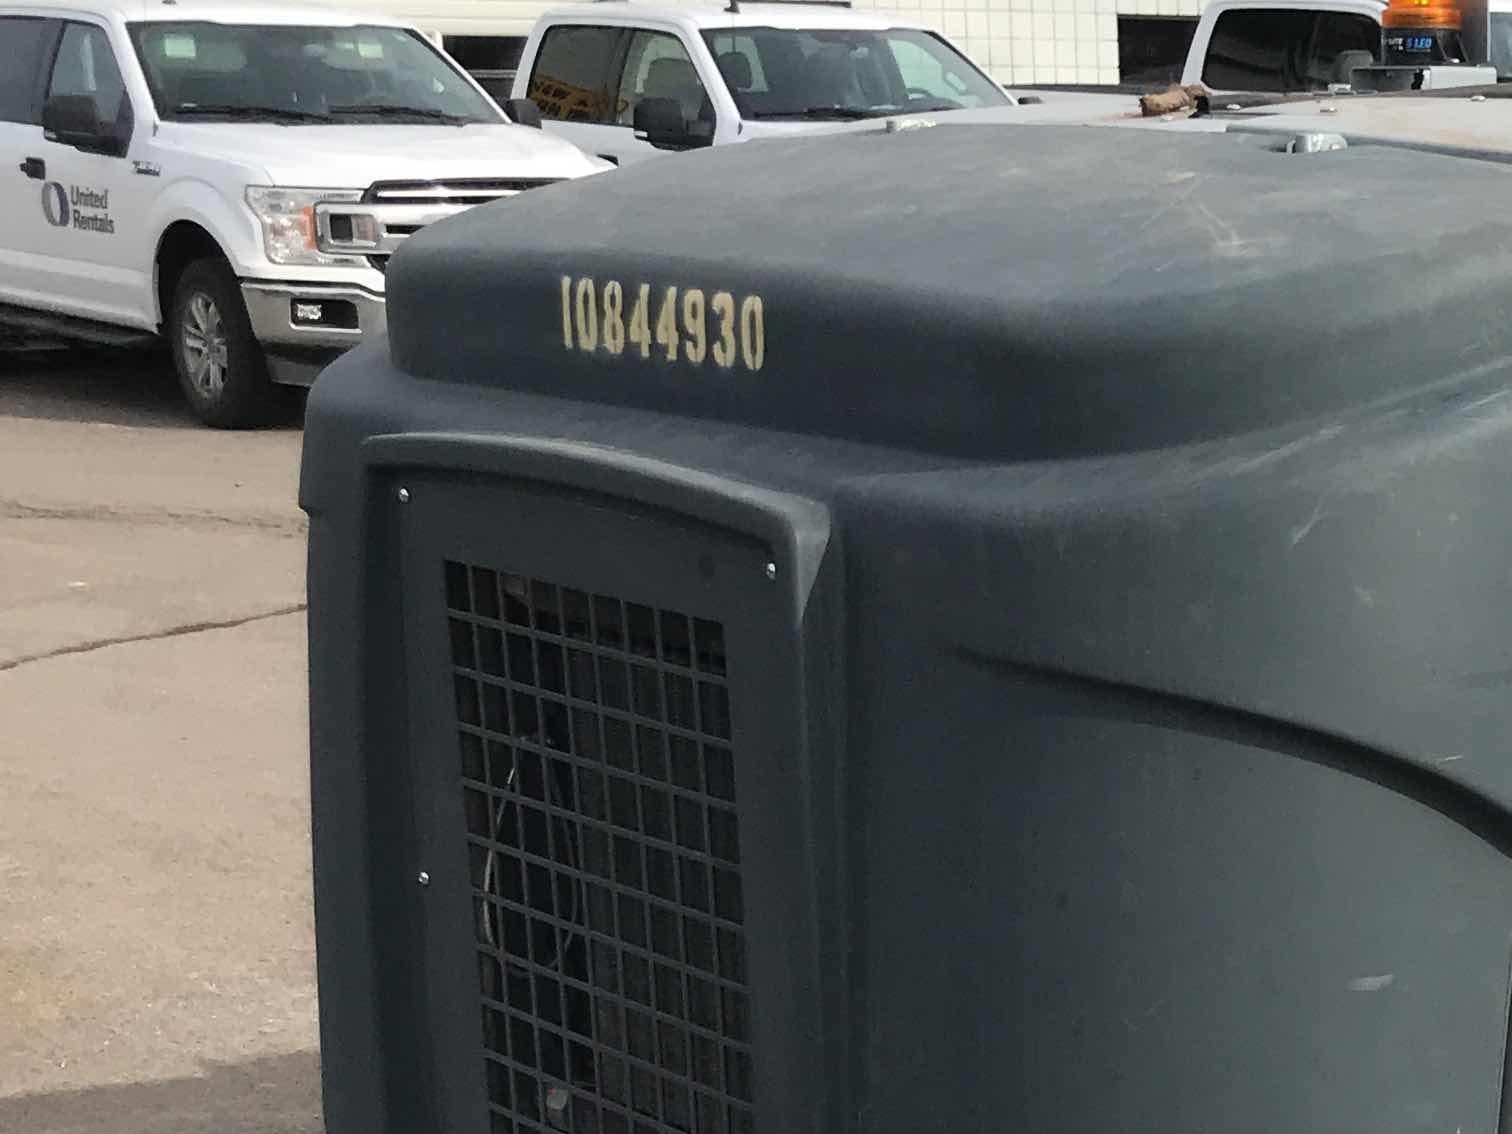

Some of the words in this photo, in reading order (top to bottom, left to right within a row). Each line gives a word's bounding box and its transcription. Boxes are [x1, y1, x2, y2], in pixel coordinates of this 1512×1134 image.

[70, 185, 109, 209] United
[72, 208, 115, 234] Rentals
[561, 275, 764, 371] 10844930
